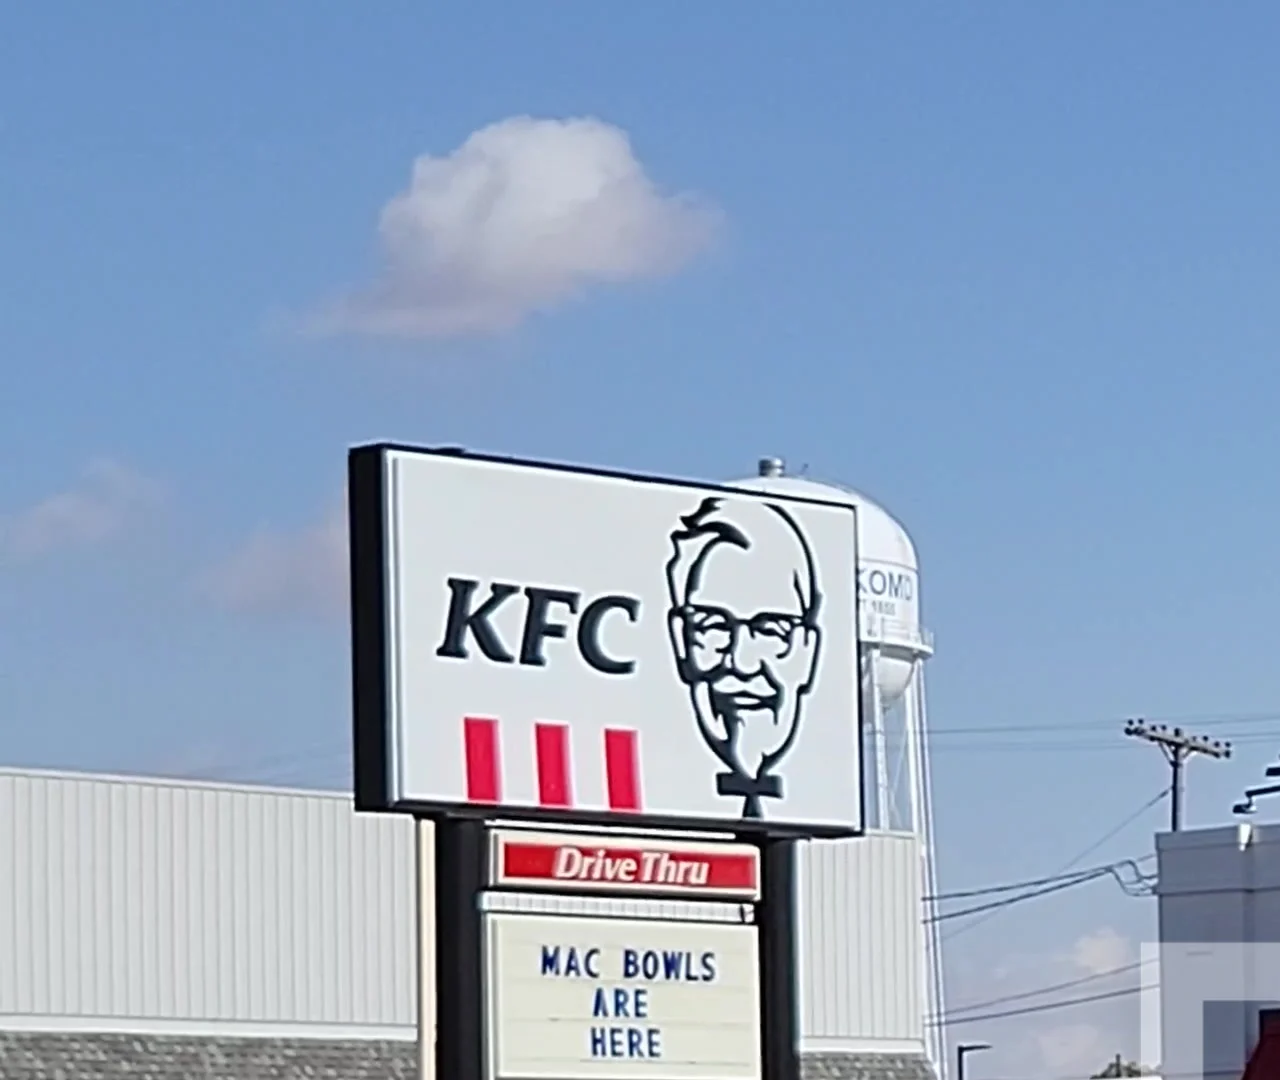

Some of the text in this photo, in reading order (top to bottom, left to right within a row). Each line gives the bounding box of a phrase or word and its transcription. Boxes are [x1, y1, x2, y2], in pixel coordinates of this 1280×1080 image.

[436, 576, 641, 675] KFC
[555, 846, 710, 885] Drive Thru
[540, 945, 717, 982] MAC BOWLS
[592, 987, 649, 1018] ARE
[590, 1026, 663, 1058] HERE
